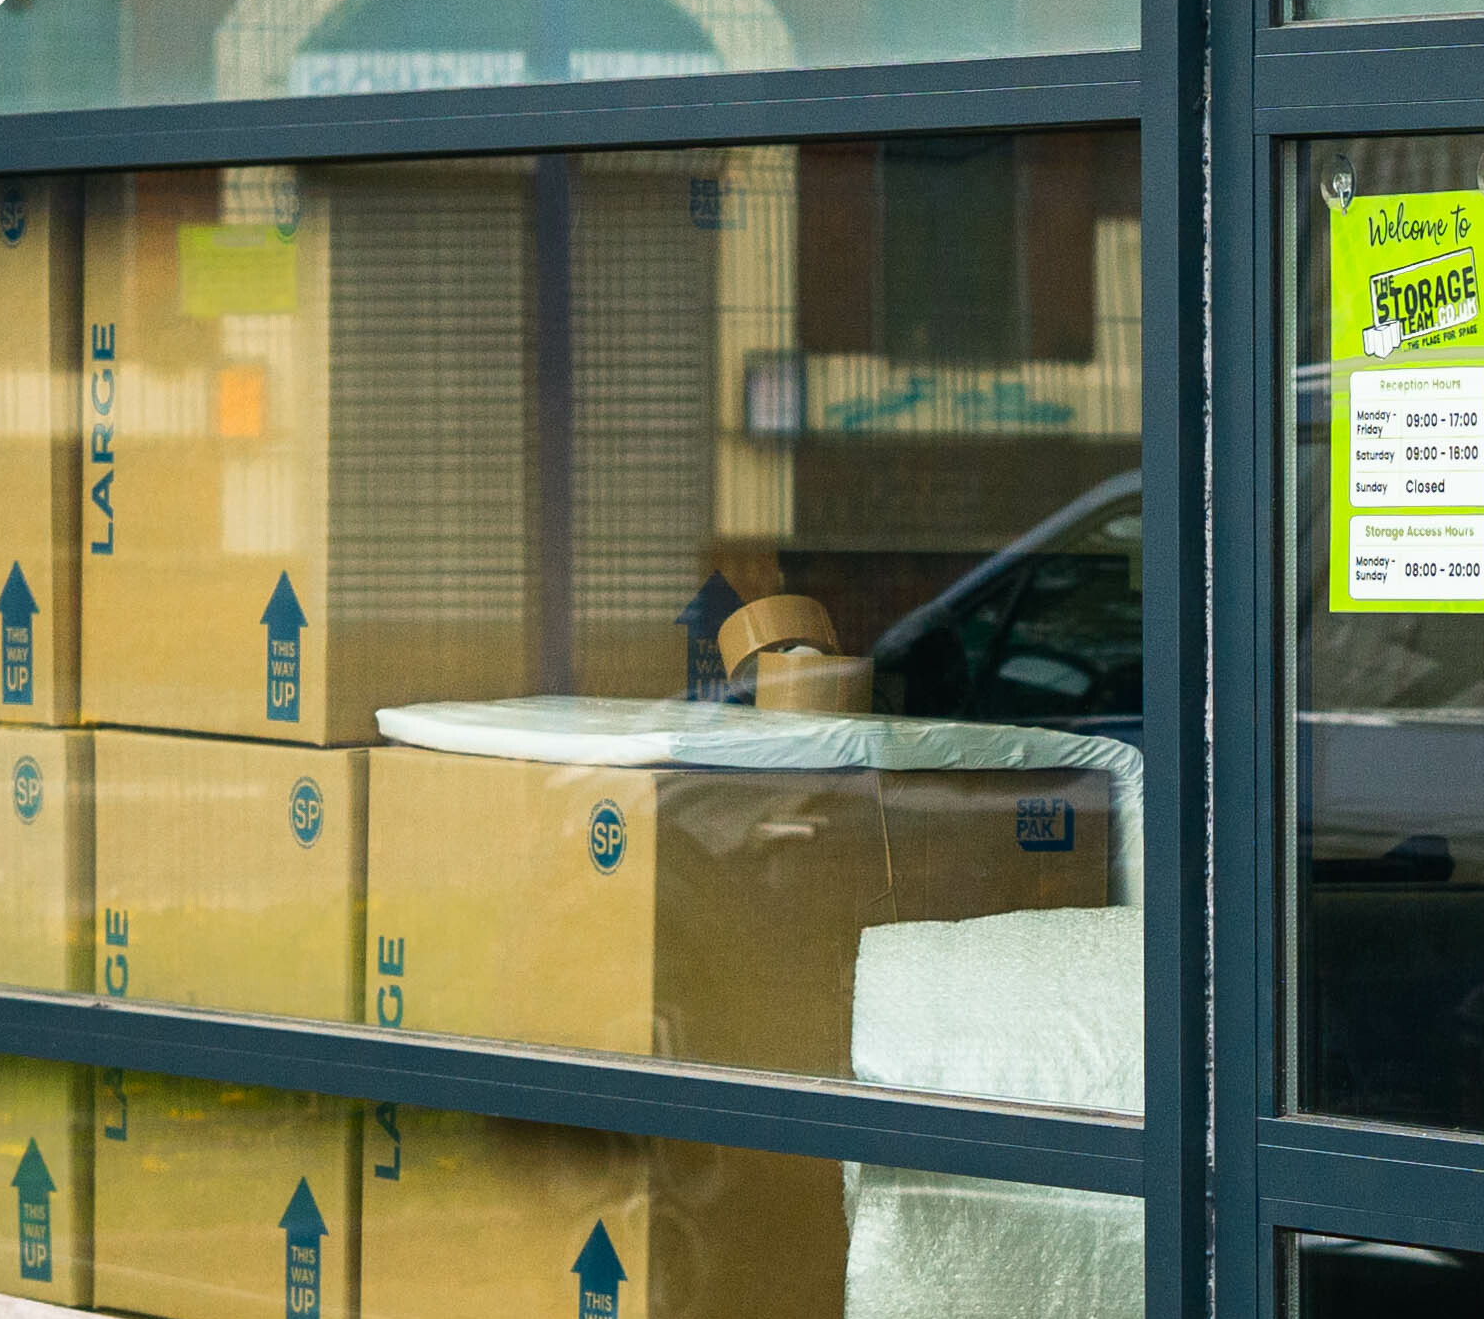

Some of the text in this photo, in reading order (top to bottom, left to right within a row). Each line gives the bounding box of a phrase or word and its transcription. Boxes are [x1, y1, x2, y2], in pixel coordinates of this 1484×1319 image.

[1369, 202, 1448, 247] Welcome
[1373, 275, 1394, 295] THE
[1376, 266, 1476, 324] STORAGE
[1422, 334, 1441, 346] PLACE
[1443, 331, 1456, 342] FOR
[1380, 379, 1461, 393] Reception Hours
[1357, 411, 1391, 423] Monday
[1406, 413, 1438, 427] 09:00
[1449, 412, 1477, 427] 17:00
[91, 322, 116, 556] LARGE
[1357, 425, 1383, 438] Friday
[1356, 450, 1395, 463] Saturday
[1406, 447, 1438, 461] 09:00
[1356, 482, 1388, 495] Sunday
[1405, 479, 1445, 493] Closed
[1365, 525, 1474, 541] Storage Access Hours
[1356, 556, 1390, 569] Monday
[1405, 563, 1437, 577] 08:00
[1449, 563, 1481, 577] 20:00
[1356, 571, 1388, 583] Sunday
[6, 626, 29, 644] THIS
[6, 646, 29, 662] WAY
[272, 640, 296, 658] THIS
[272, 659, 296, 678] WAY
[6, 665, 30, 692] UP
[272, 680, 296, 708] UP
[16, 776, 41, 807] SP
[294, 798, 320, 828] SP
[1016, 798, 1062, 818] SELF
[594, 822, 621, 855] SP
[1016, 819, 1056, 840] PAK
[23, 1204, 46, 1221] THIS
[23, 1224, 47, 1241] WAY
[24, 1243, 47, 1268] UP
[291, 1245, 316, 1264] THIS
[291, 1266, 316, 1284] WAY
[290, 1286, 316, 1313] UP
[585, 1293, 612, 1312] THIS
